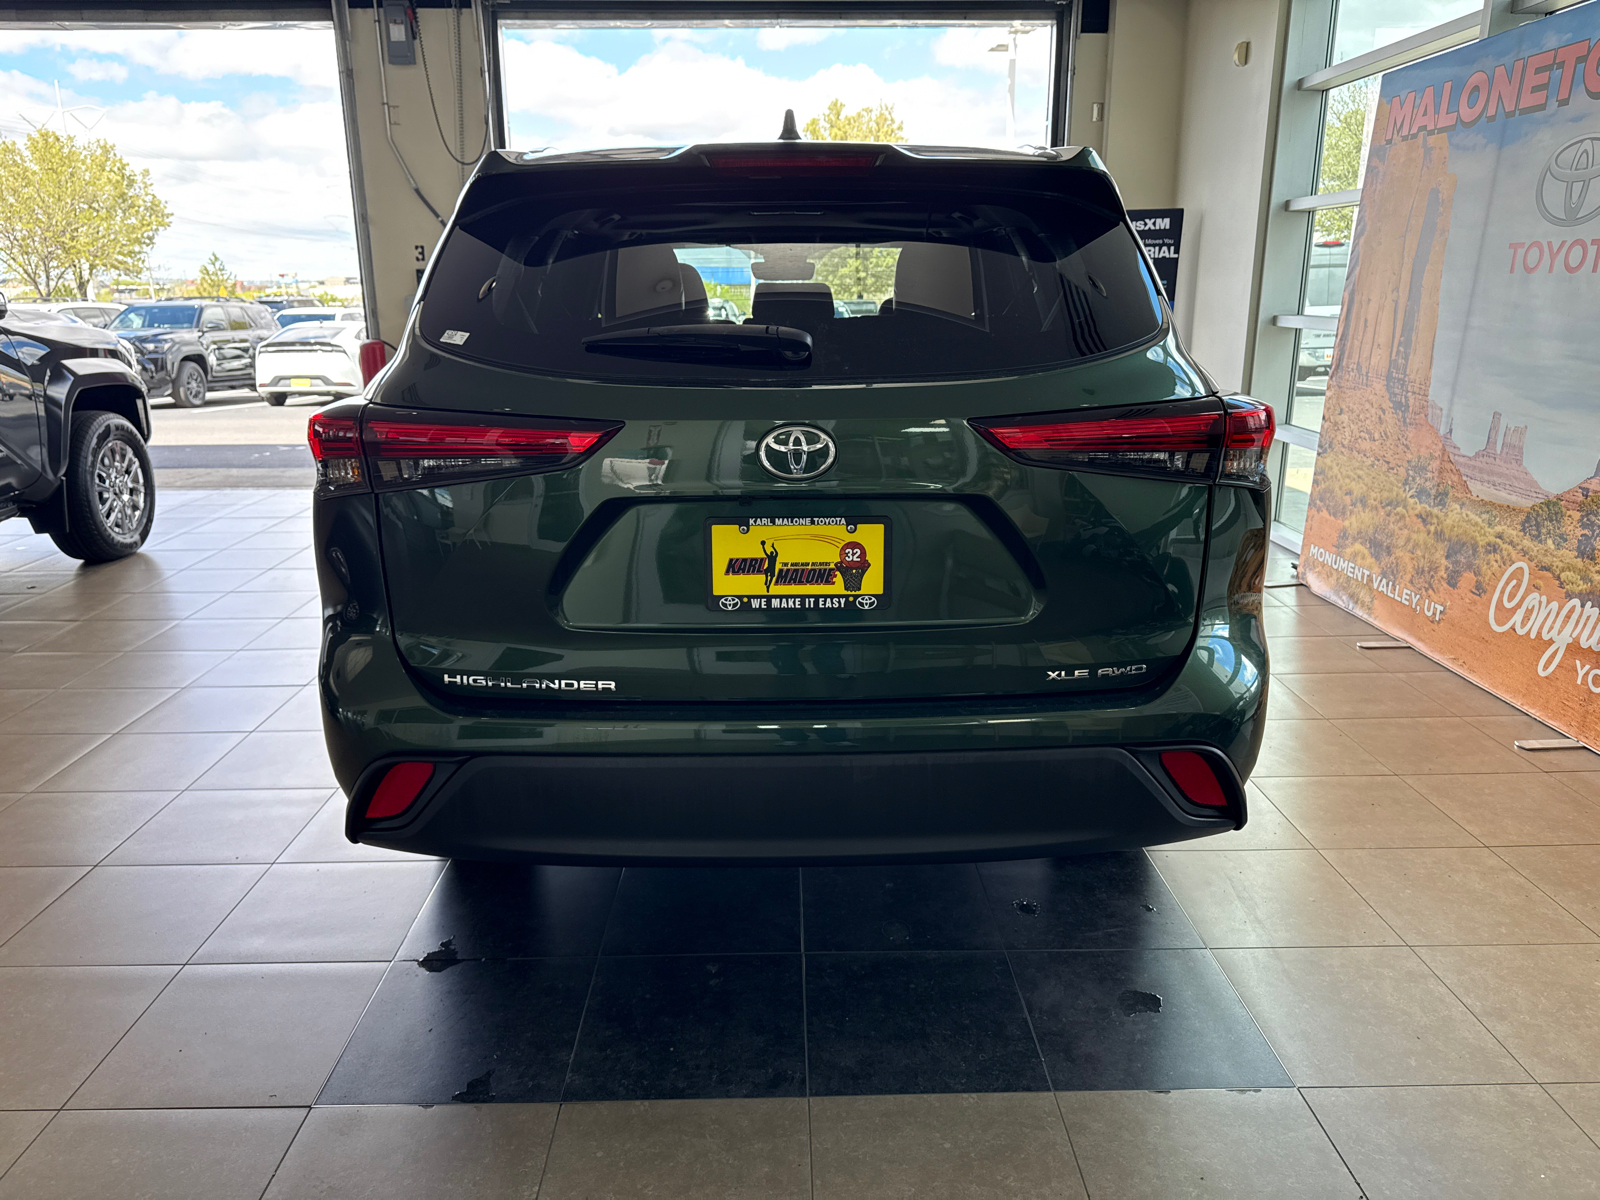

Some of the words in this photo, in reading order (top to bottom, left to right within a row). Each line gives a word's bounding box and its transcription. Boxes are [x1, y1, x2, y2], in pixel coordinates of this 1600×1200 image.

[415, 245, 425, 261] 3
[749, 518, 773, 526] KARL
[775, 518, 811, 526] MALONE
[813, 517, 846, 526] TOYOTA
[845, 548, 861, 562] 32
[725, 557, 767, 575] KARL
[774, 568, 837, 585] MALONE
[1309, 544, 1371, 584] MONUMENT
[1372, 573, 1421, 614] VALLEY,
[1424, 601, 1444, 620] UT
[751, 598, 767, 608] WE
[771, 598, 801, 608] MAKE
[805, 598, 814, 608] IT
[819, 597, 846, 608] EASY
[1046, 669, 1089, 680] XLE
[1098, 664, 1146, 677] AWD
[444, 674, 616, 691] HIGHLANDER
